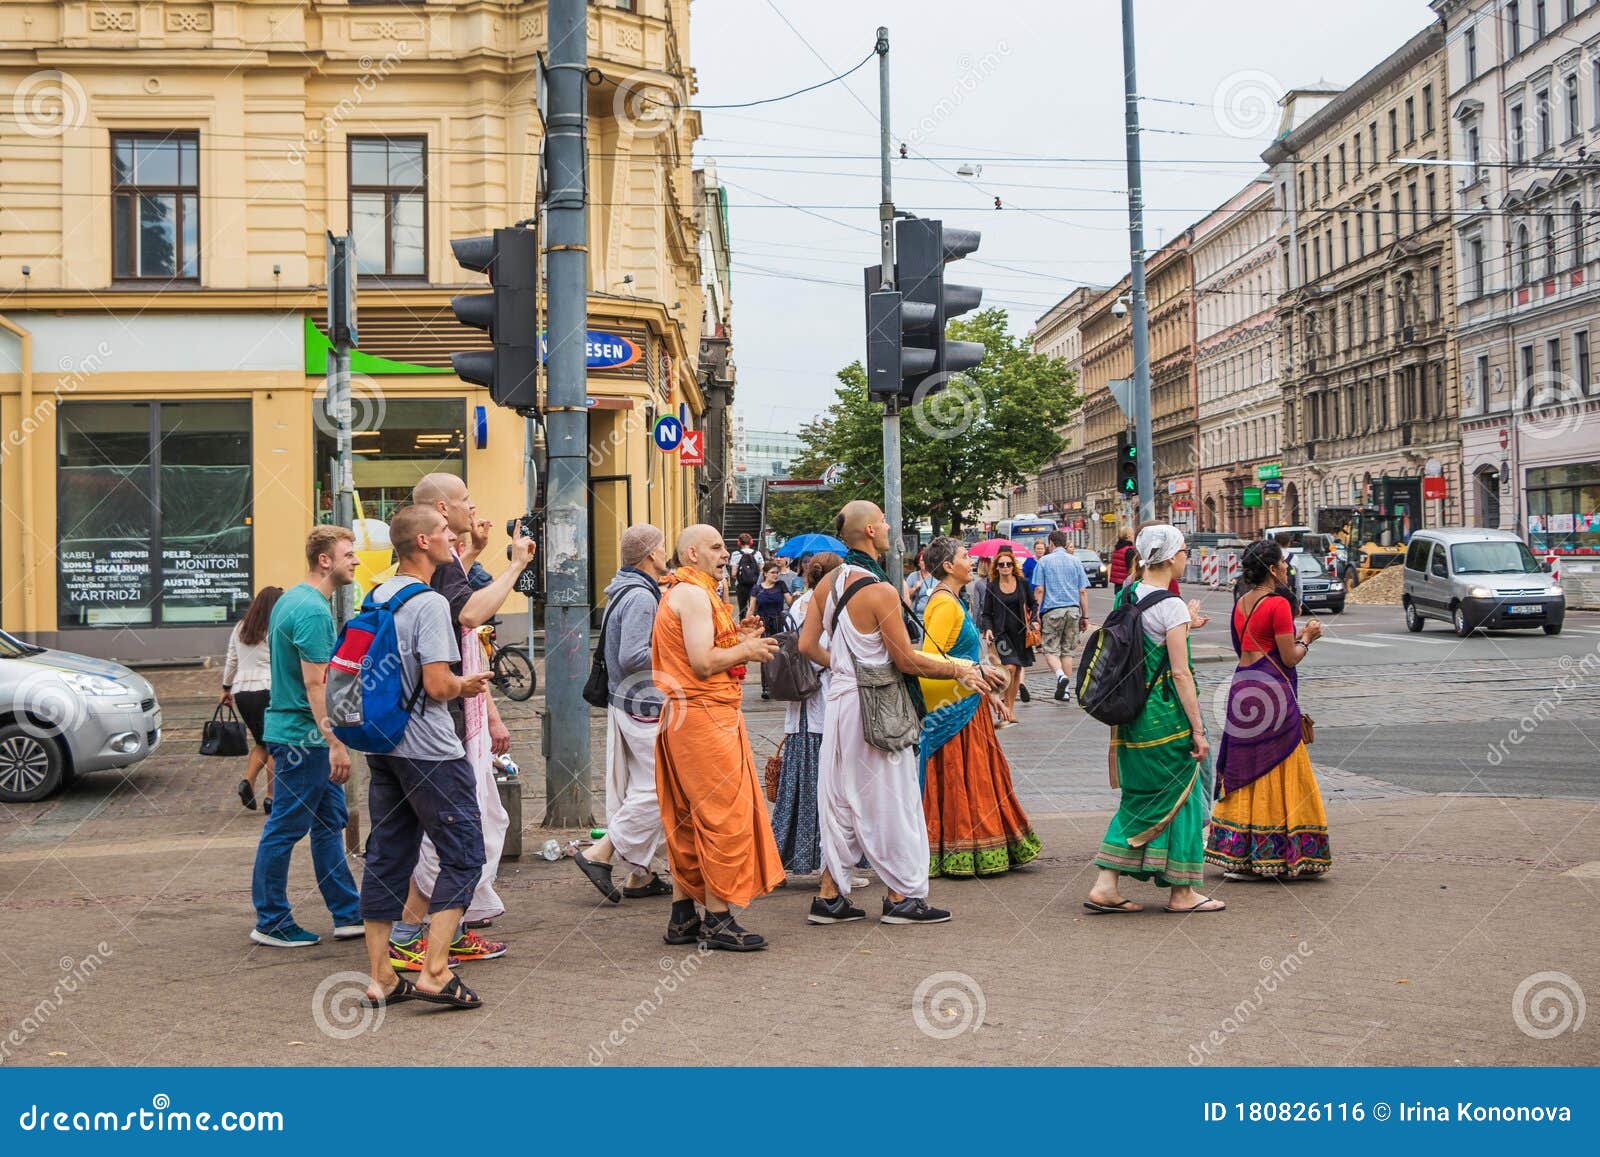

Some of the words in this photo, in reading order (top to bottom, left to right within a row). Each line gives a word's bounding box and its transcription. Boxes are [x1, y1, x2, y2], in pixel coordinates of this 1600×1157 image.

[660, 425, 677, 441] N
[175, 559, 239, 569] MONITORI
[71, 588, 140, 600] KĀRTRIDŽI
